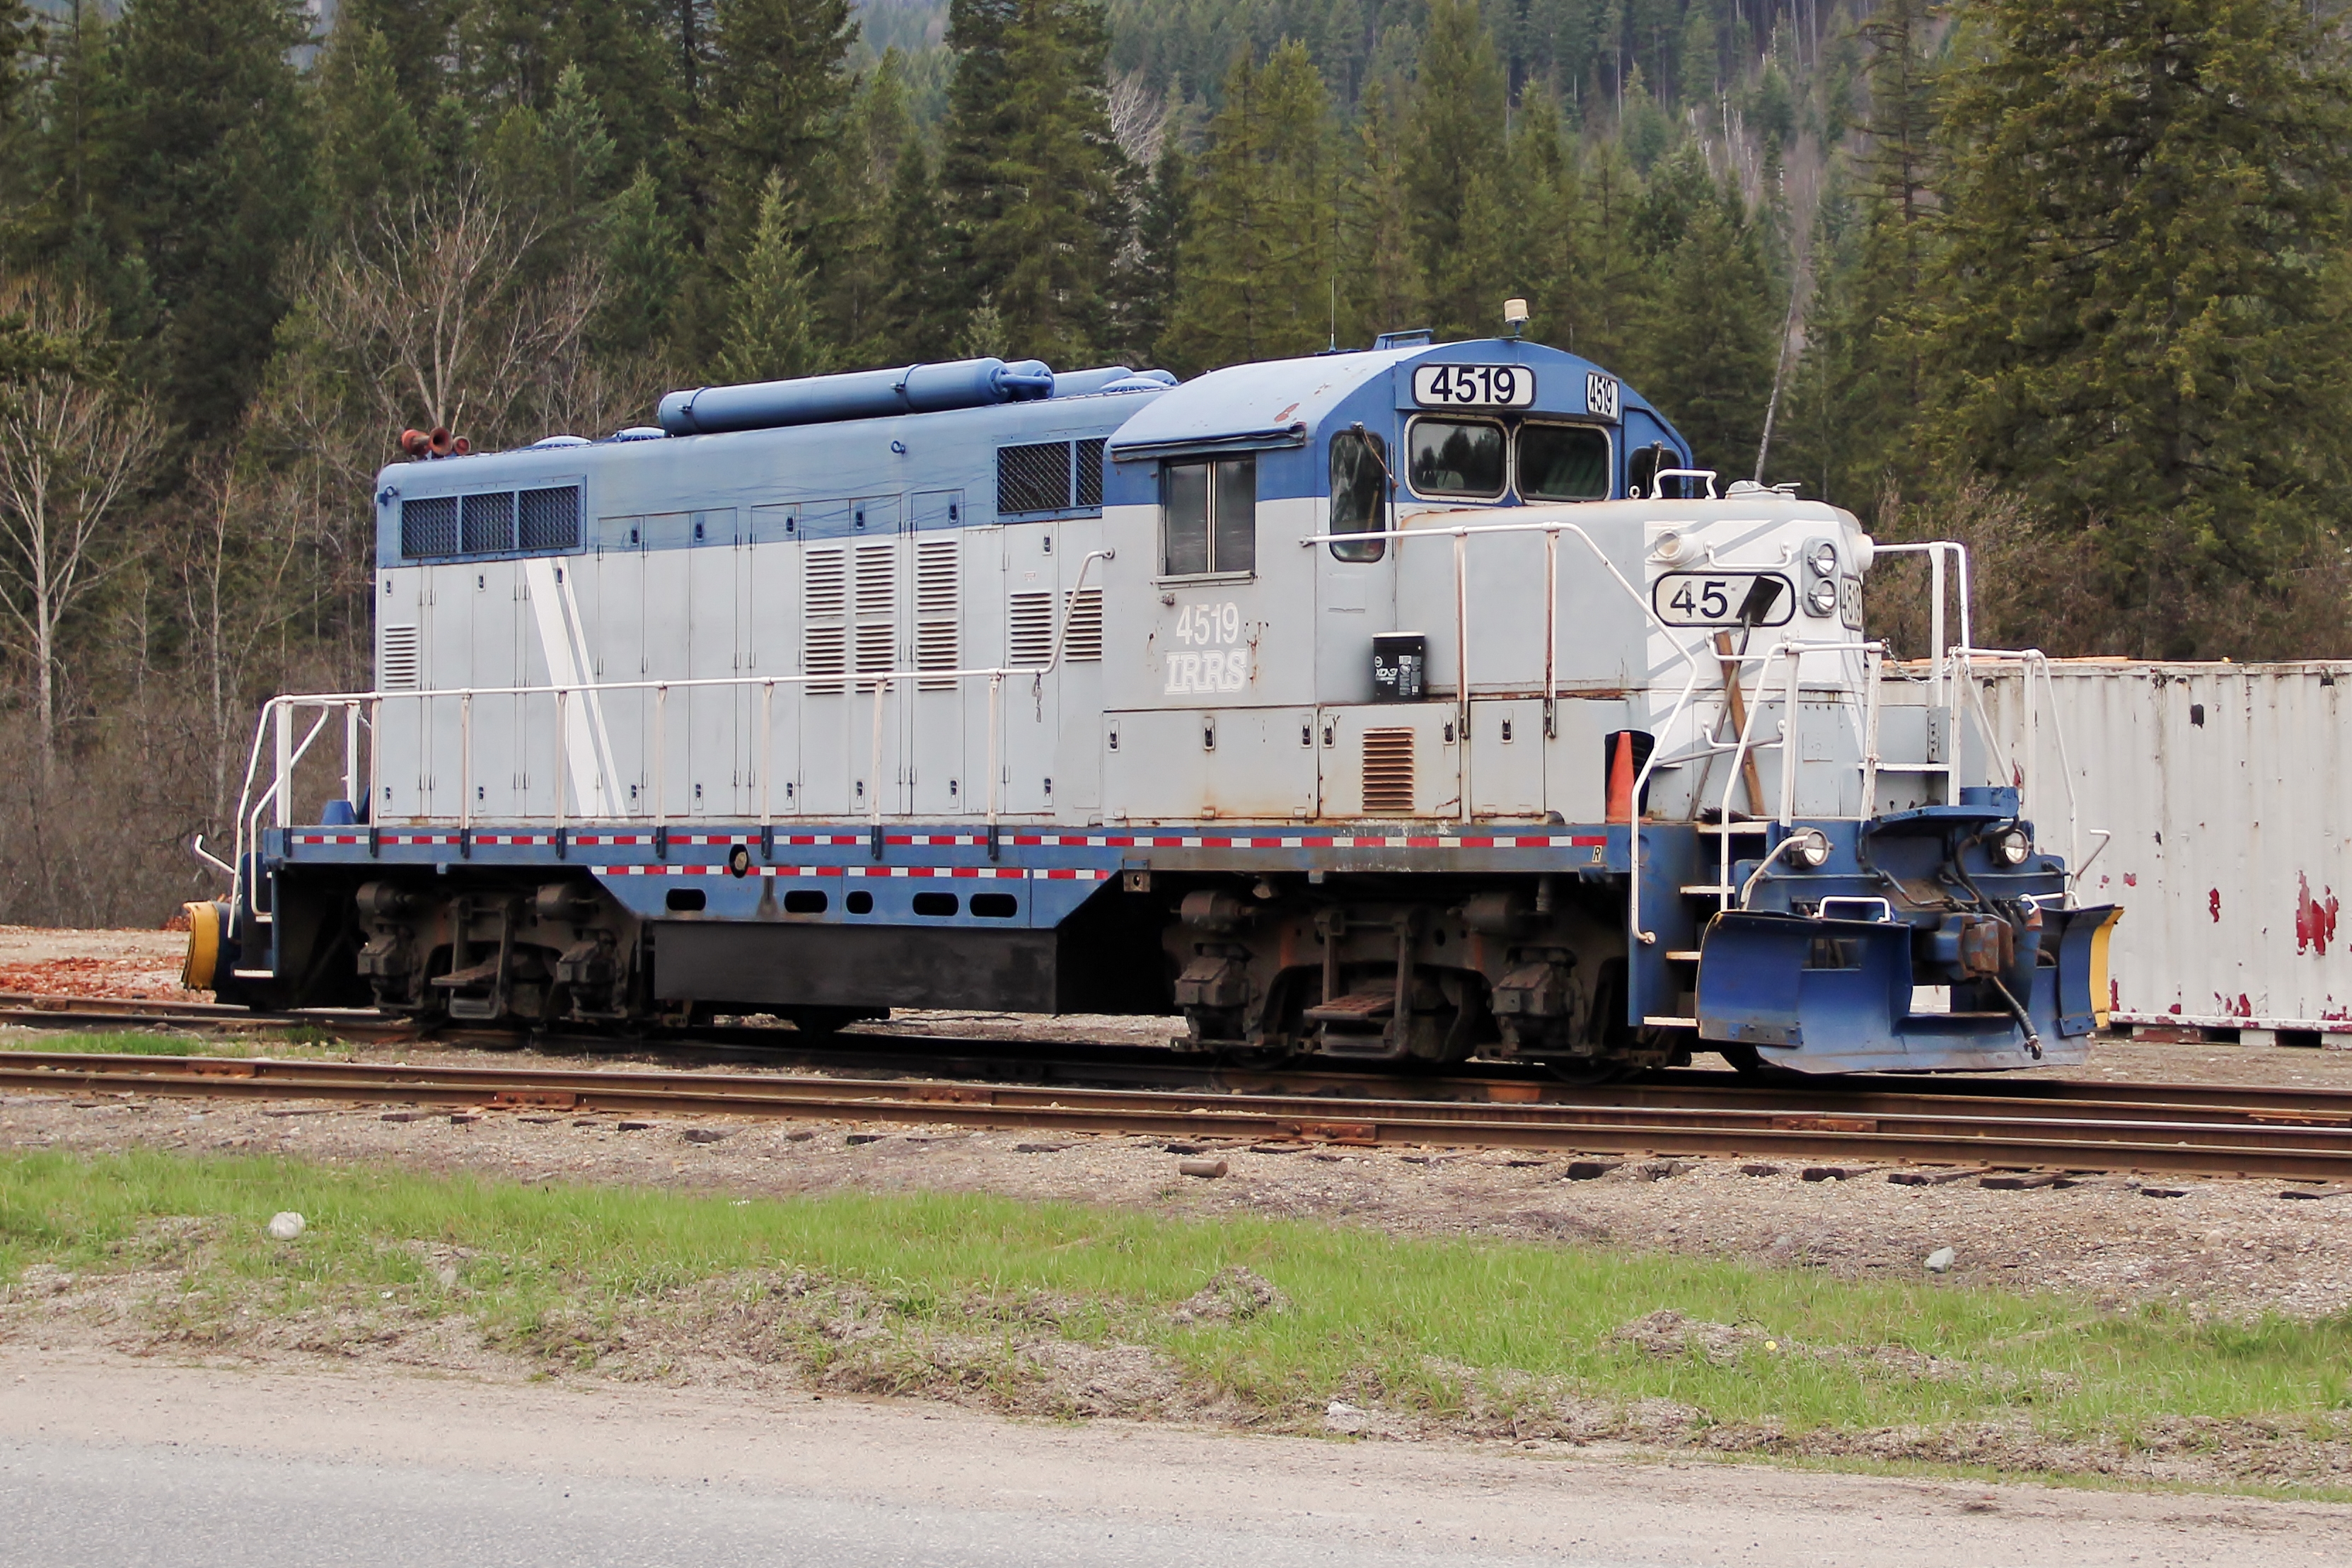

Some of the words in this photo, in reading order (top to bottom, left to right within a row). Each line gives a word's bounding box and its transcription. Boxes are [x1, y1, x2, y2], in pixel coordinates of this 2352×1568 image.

[1430, 366, 1515, 404] 4519
[1590, 376, 1612, 414] 4519
[1841, 582, 1860, 622] 4519
[1176, 602, 1239, 644] 4519
[1164, 648, 1247, 695] IRRS
[1593, 847, 1601, 861] R
